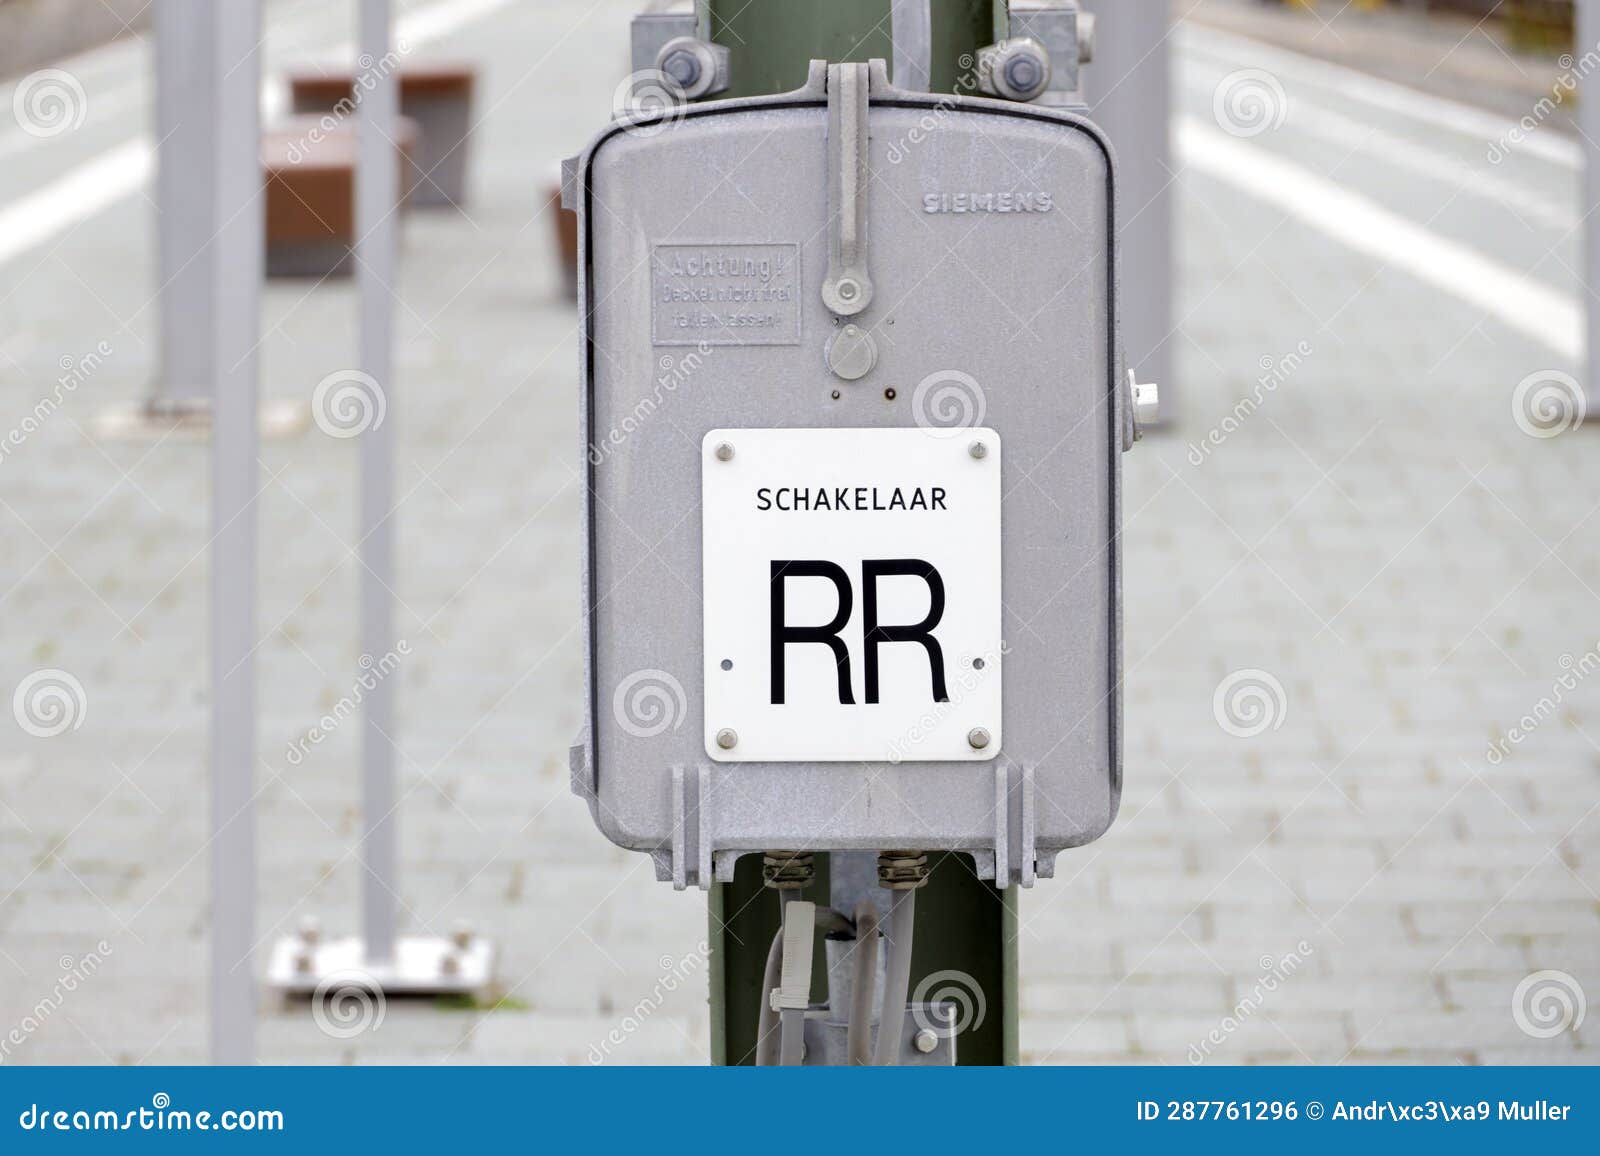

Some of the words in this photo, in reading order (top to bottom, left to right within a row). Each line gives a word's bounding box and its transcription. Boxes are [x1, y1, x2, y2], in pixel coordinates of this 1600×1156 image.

[923, 192, 1053, 213] SIEMENS
[671, 252, 786, 283] Achtung!
[757, 487, 947, 511] SCHAKELAAR
[770, 558, 950, 704] RR
